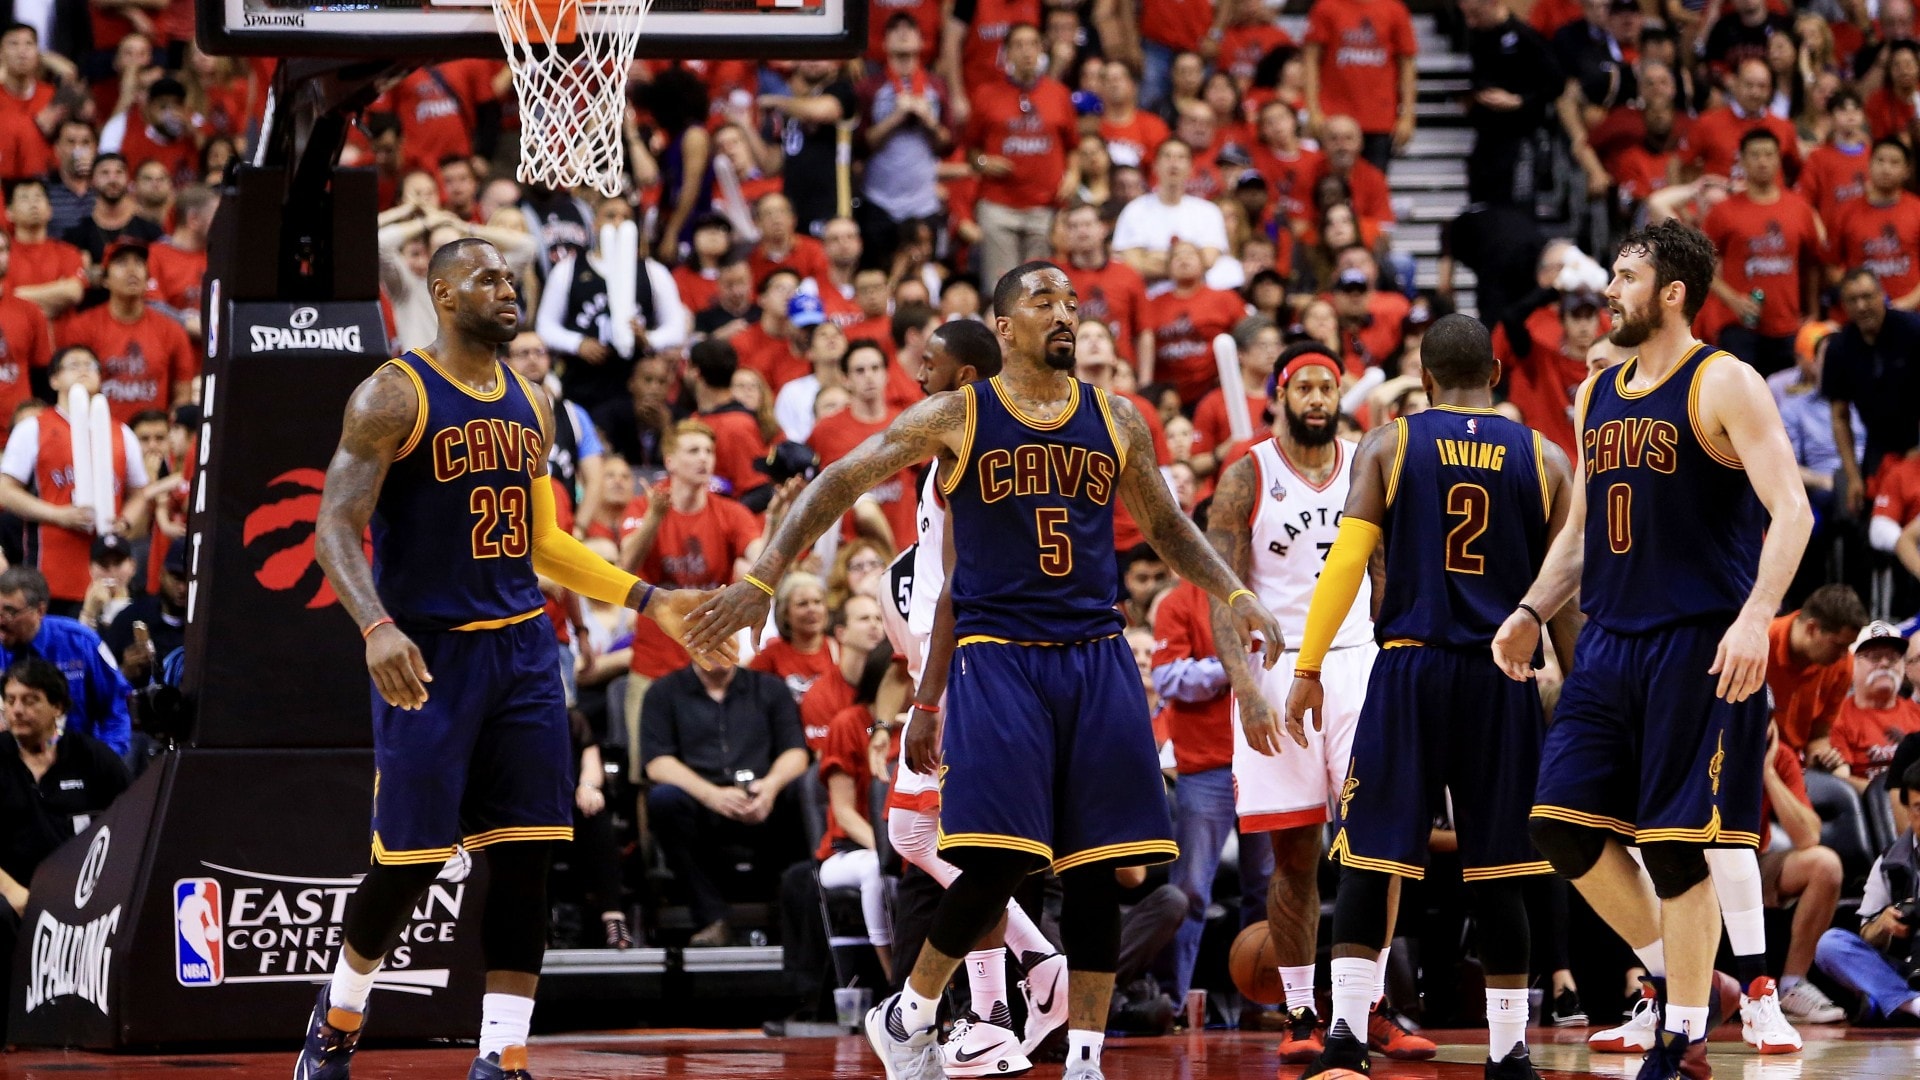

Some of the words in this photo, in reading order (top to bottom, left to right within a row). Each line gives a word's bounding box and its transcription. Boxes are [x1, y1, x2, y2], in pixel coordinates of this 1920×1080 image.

[243, 13, 304, 28] SPALDING
[250, 325, 364, 353] SPALDING
[195, 373, 216, 514] NBA
[432, 418, 542, 483] CAVS
[978, 444, 1115, 506] CAVS
[1436, 438, 1507, 472] IRVING
[1584, 417, 1678, 484] CAVS
[470, 486, 528, 559] 23
[1035, 507, 1072, 577] 5
[1445, 482, 1489, 575] 2
[1608, 482, 1632, 554] 0
[187, 532, 202, 624] TV
[898, 576, 912, 614] 5
[227, 883, 466, 927] EASTN
[227, 922, 456, 950] CONFECE
[26, 904, 122, 1016] SPALDING
[182, 962, 210, 979] NBA
[258, 946, 412, 974] FINS
